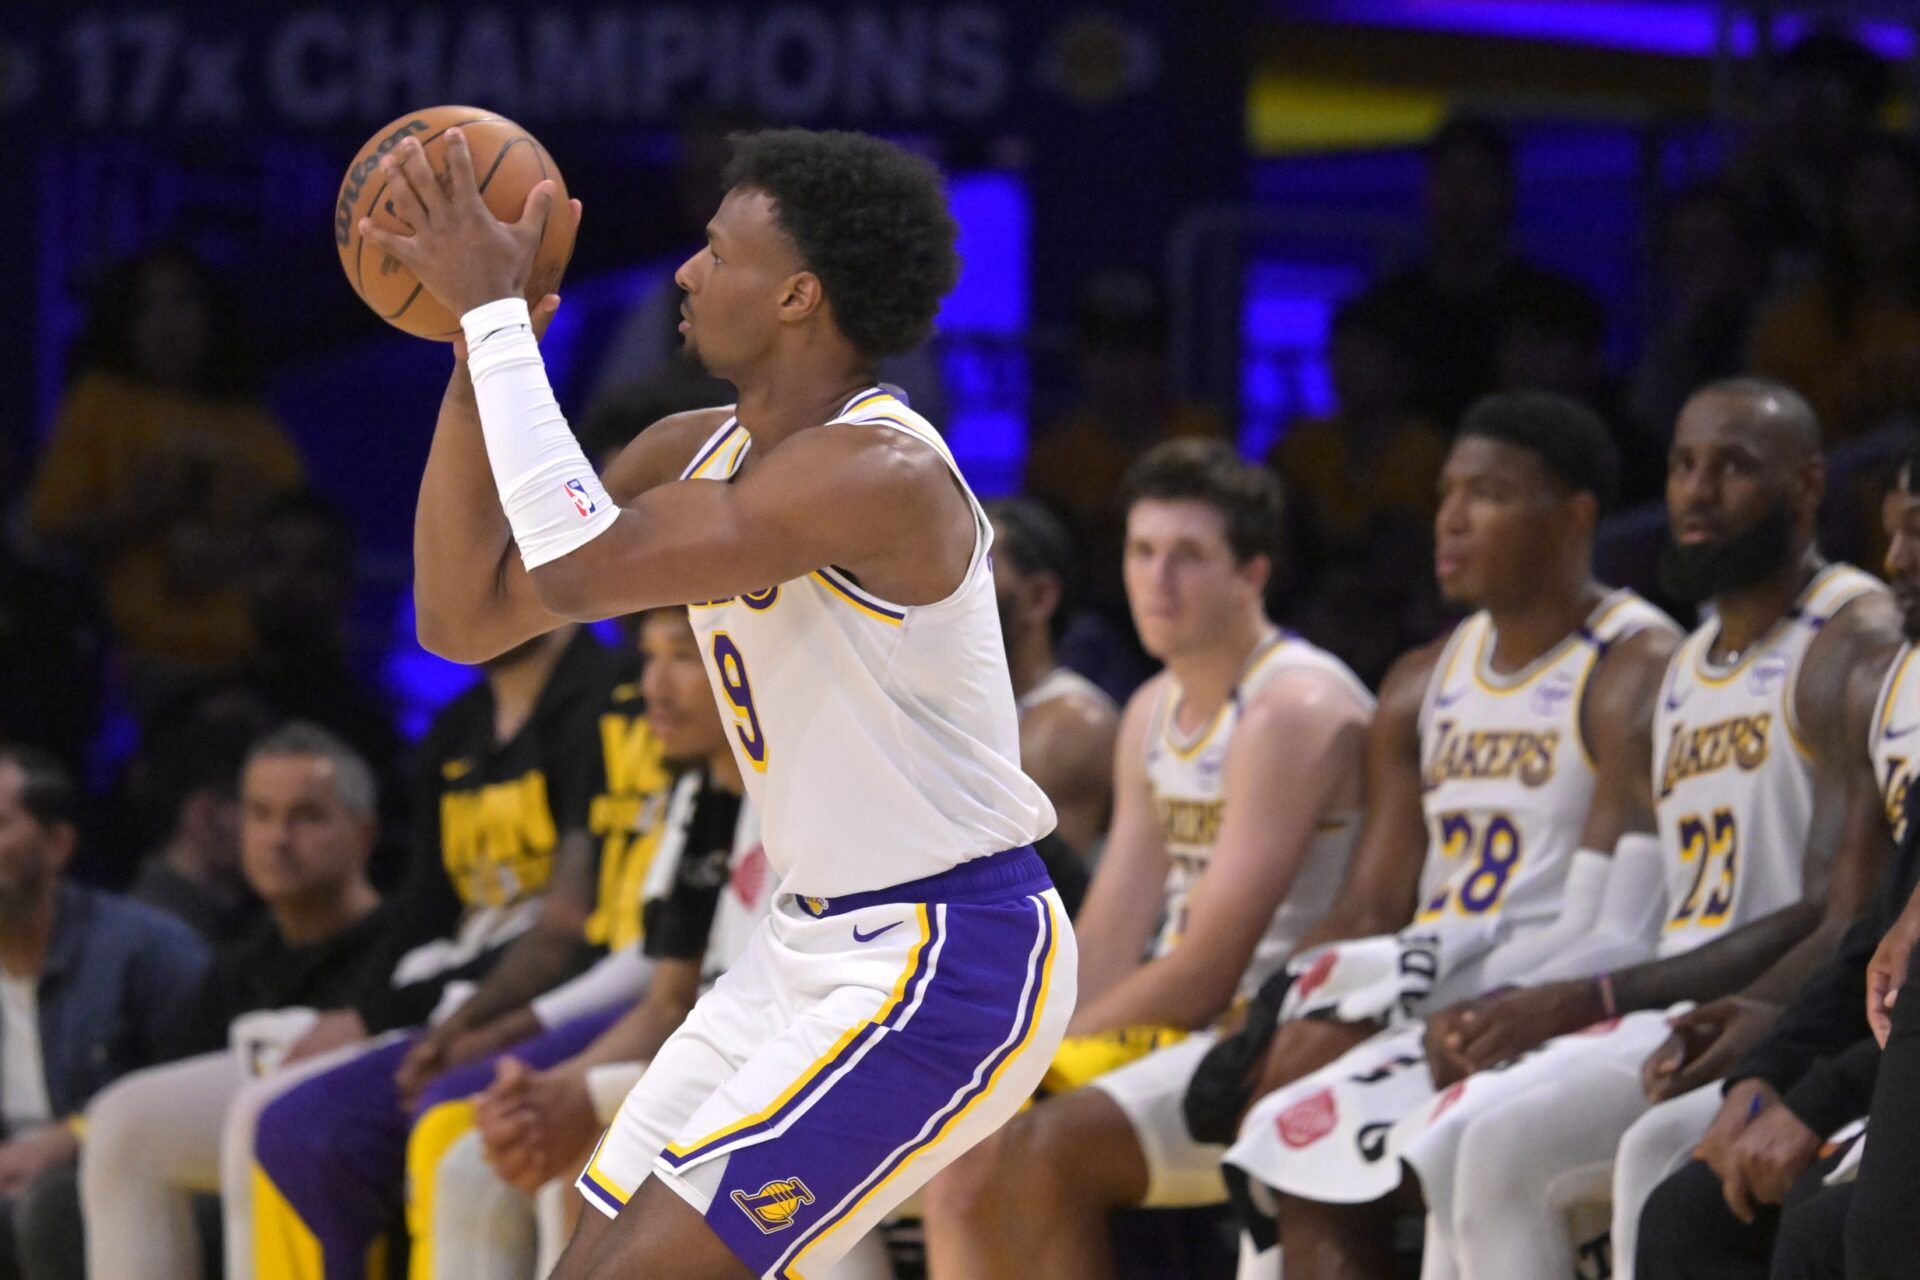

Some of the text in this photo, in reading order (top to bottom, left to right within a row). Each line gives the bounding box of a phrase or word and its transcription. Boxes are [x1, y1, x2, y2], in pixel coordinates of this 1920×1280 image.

[70, 6, 1006, 122] 17x CHAMPIONS
[711, 630, 769, 774] 9
[1422, 716, 1560, 792] LAKERS
[1660, 711, 1771, 799] LAKERS
[1415, 811, 1521, 922] 28
[1664, 804, 1739, 932] 23
